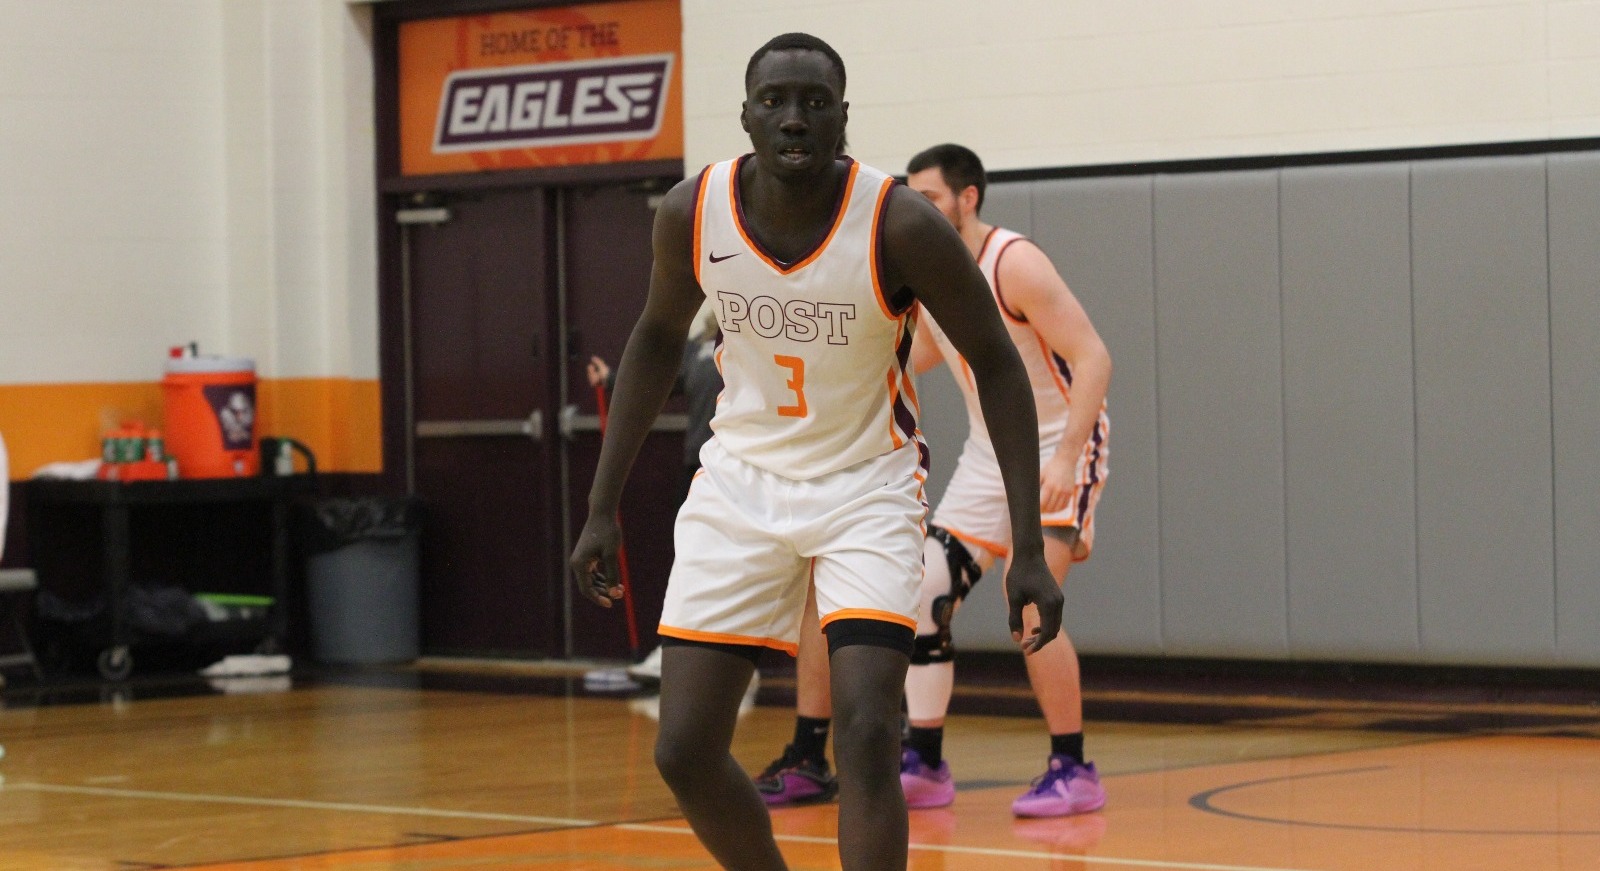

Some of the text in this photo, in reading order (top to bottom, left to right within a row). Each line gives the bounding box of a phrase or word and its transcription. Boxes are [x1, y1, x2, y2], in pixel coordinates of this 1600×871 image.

[480, 22, 620, 56] HOME OF THE
[448, 72, 659, 136] EAGLES
[717, 291, 856, 346] POST
[773, 354, 808, 418] 3
